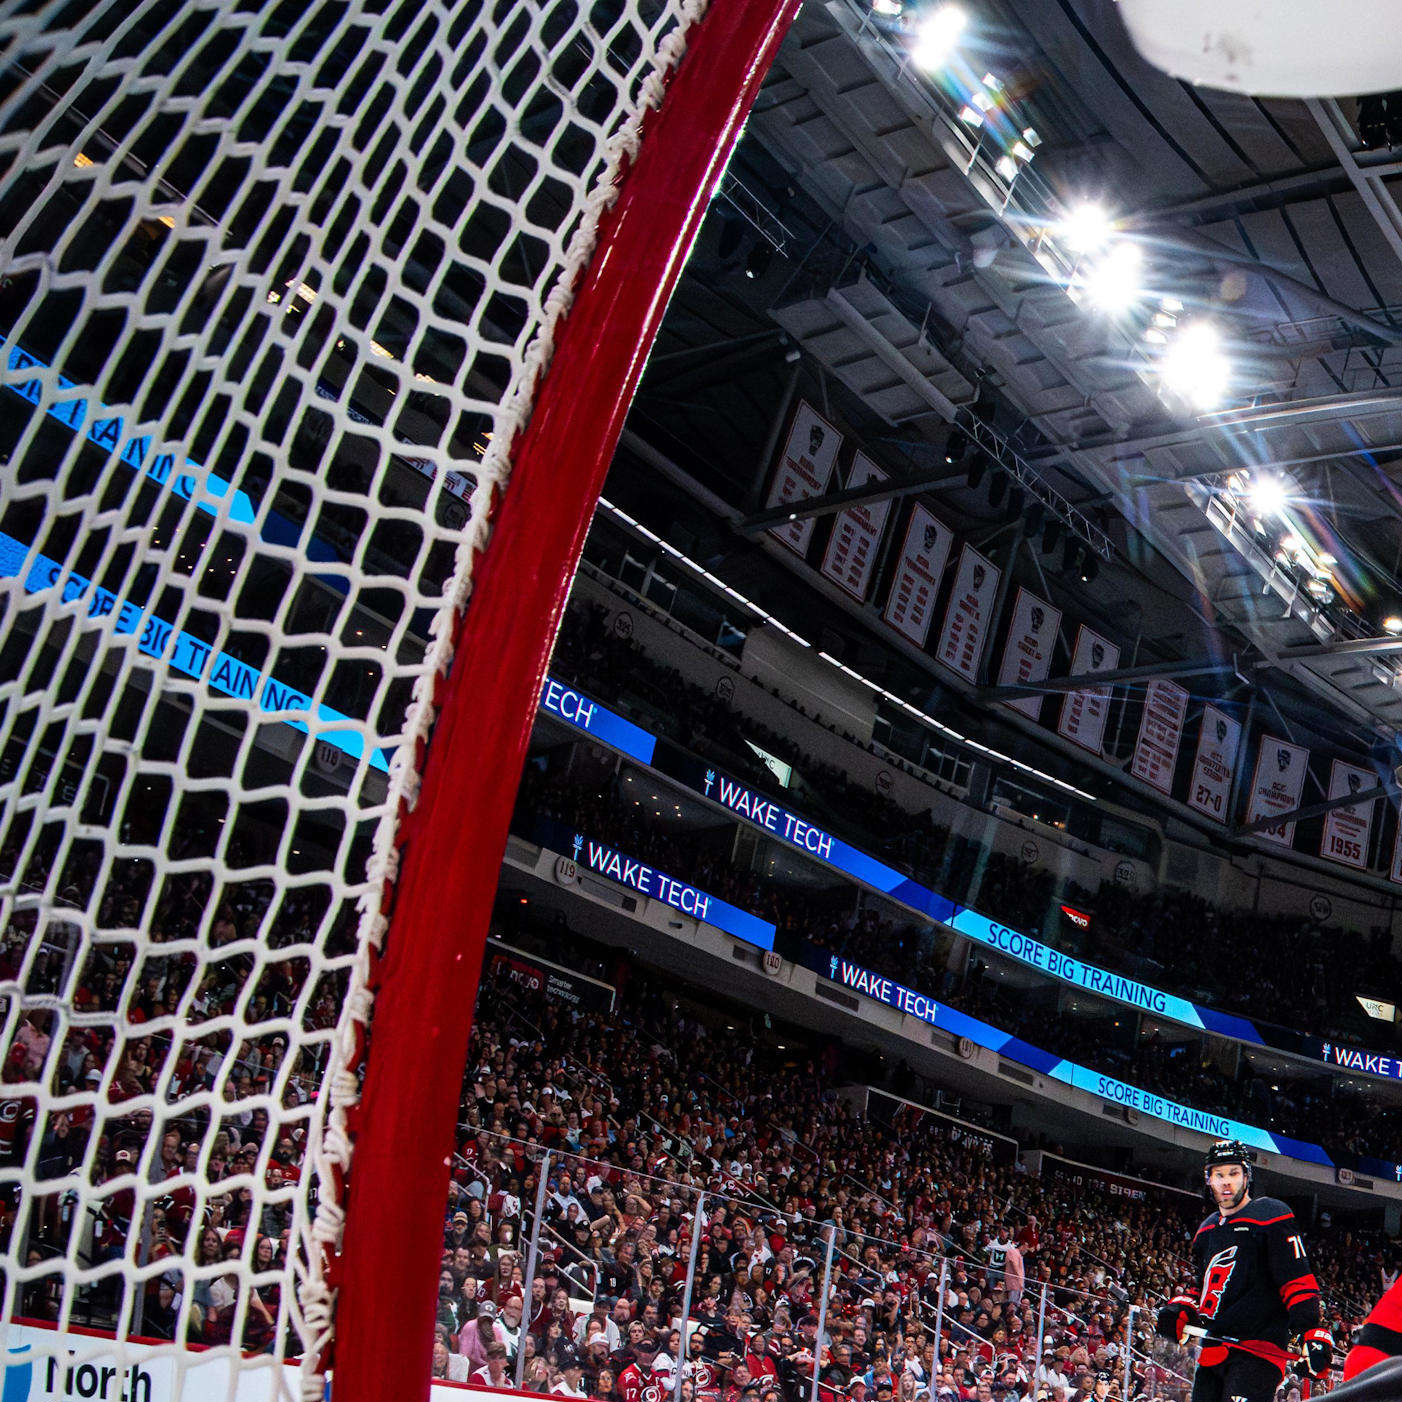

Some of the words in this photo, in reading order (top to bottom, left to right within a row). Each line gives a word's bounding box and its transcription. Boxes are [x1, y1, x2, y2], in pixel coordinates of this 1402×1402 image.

[545, 678, 594, 729] ECH
[719, 777, 780, 832] WAKE
[784, 813, 834, 859] TECH
[559, 860, 576, 877] 119
[1330, 835, 1361, 860] 1955
[589, 841, 652, 893] WAKE
[658, 874, 709, 919] TECH
[1065, 912, 1088, 927] ovo
[766, 955, 780, 970] 120
[987, 922, 1044, 966] SCORE
[1047, 952, 1076, 980] BIG
[1080, 964, 1166, 1013] TRAINING
[842, 961, 891, 1003] WAKE
[896, 986, 937, 1023] TECH
[1335, 1046, 1391, 1075] WAKE
[1098, 1076, 1141, 1108] SCORE
[1143, 1094, 1163, 1117] BIG
[1165, 1101, 1230, 1138] TRAINING
